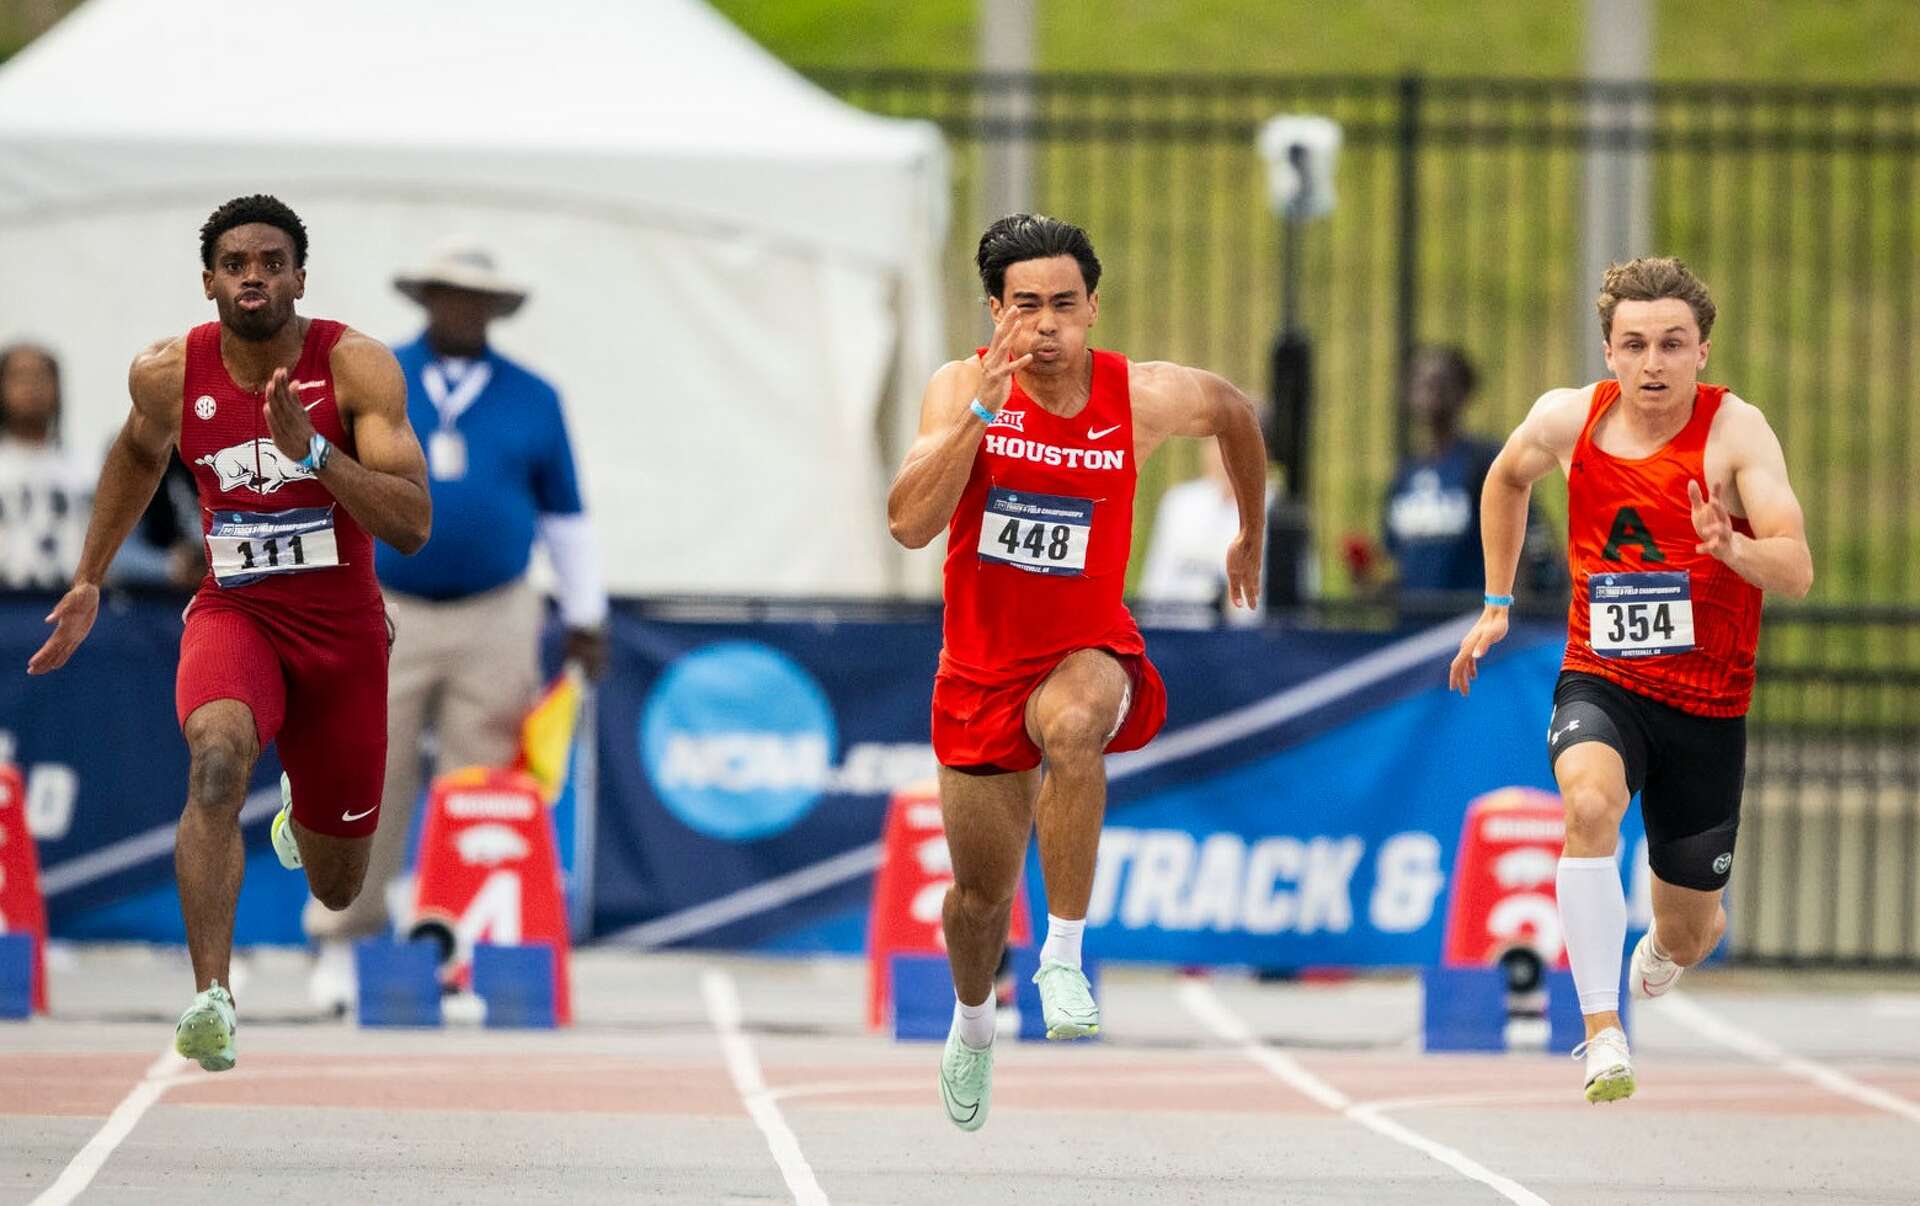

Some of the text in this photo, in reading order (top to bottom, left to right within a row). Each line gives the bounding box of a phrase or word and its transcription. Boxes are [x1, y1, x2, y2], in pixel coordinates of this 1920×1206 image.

[984, 434, 1125, 470] HOUSTON
[237, 535, 304, 570] 111
[998, 518, 1070, 560] 448
[1601, 504, 1666, 562] A
[1606, 603, 1675, 643] 354
[1086, 826, 1445, 936] TRACK &
